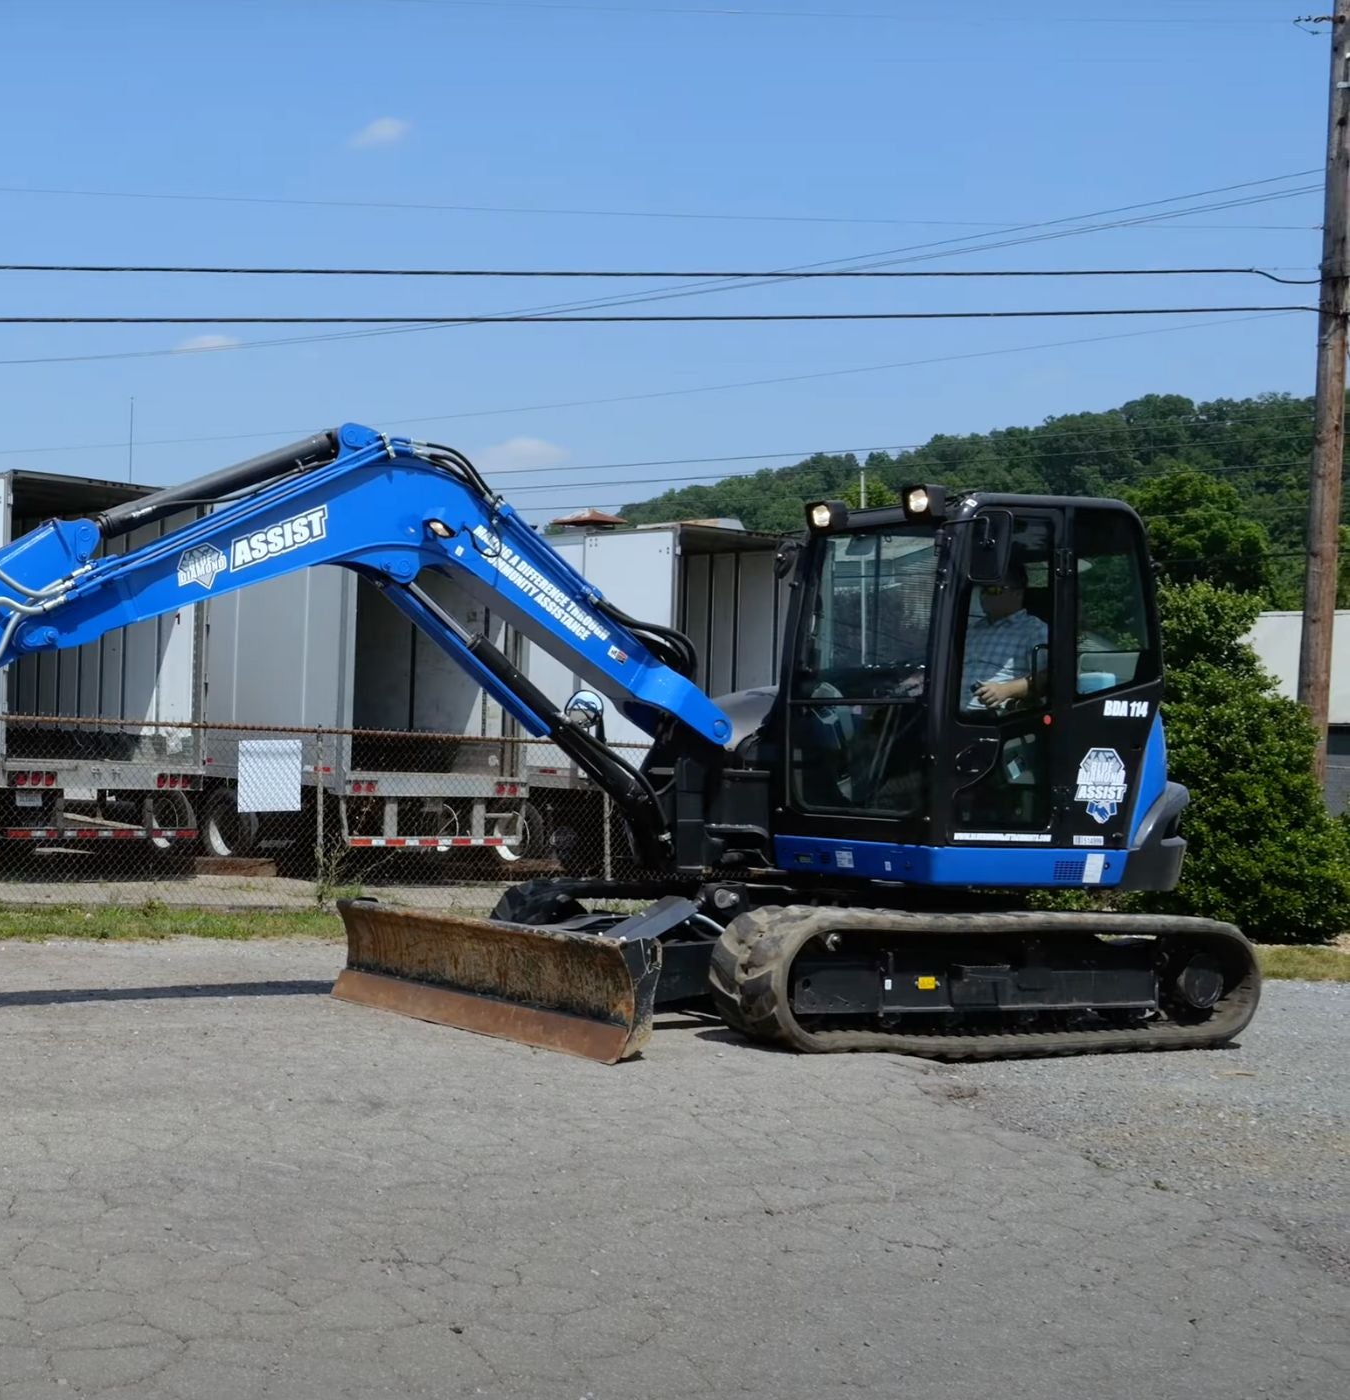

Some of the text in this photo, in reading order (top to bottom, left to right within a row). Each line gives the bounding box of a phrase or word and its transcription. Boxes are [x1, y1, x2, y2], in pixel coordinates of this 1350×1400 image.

[231, 505, 327, 571] ASSIST
[178, 556, 227, 586] DIAMOND
[482, 548, 591, 641] COMMUNITY ASSISTANCE
[508, 554, 519, 566] A
[517, 558, 570, 607] DIFFERENCE
[565, 599, 610, 641] THROUGH
[1103, 701, 1149, 717] BDA 114
[1077, 769, 1126, 785] DIAMOND
[1075, 785, 1126, 801] ASSIST
